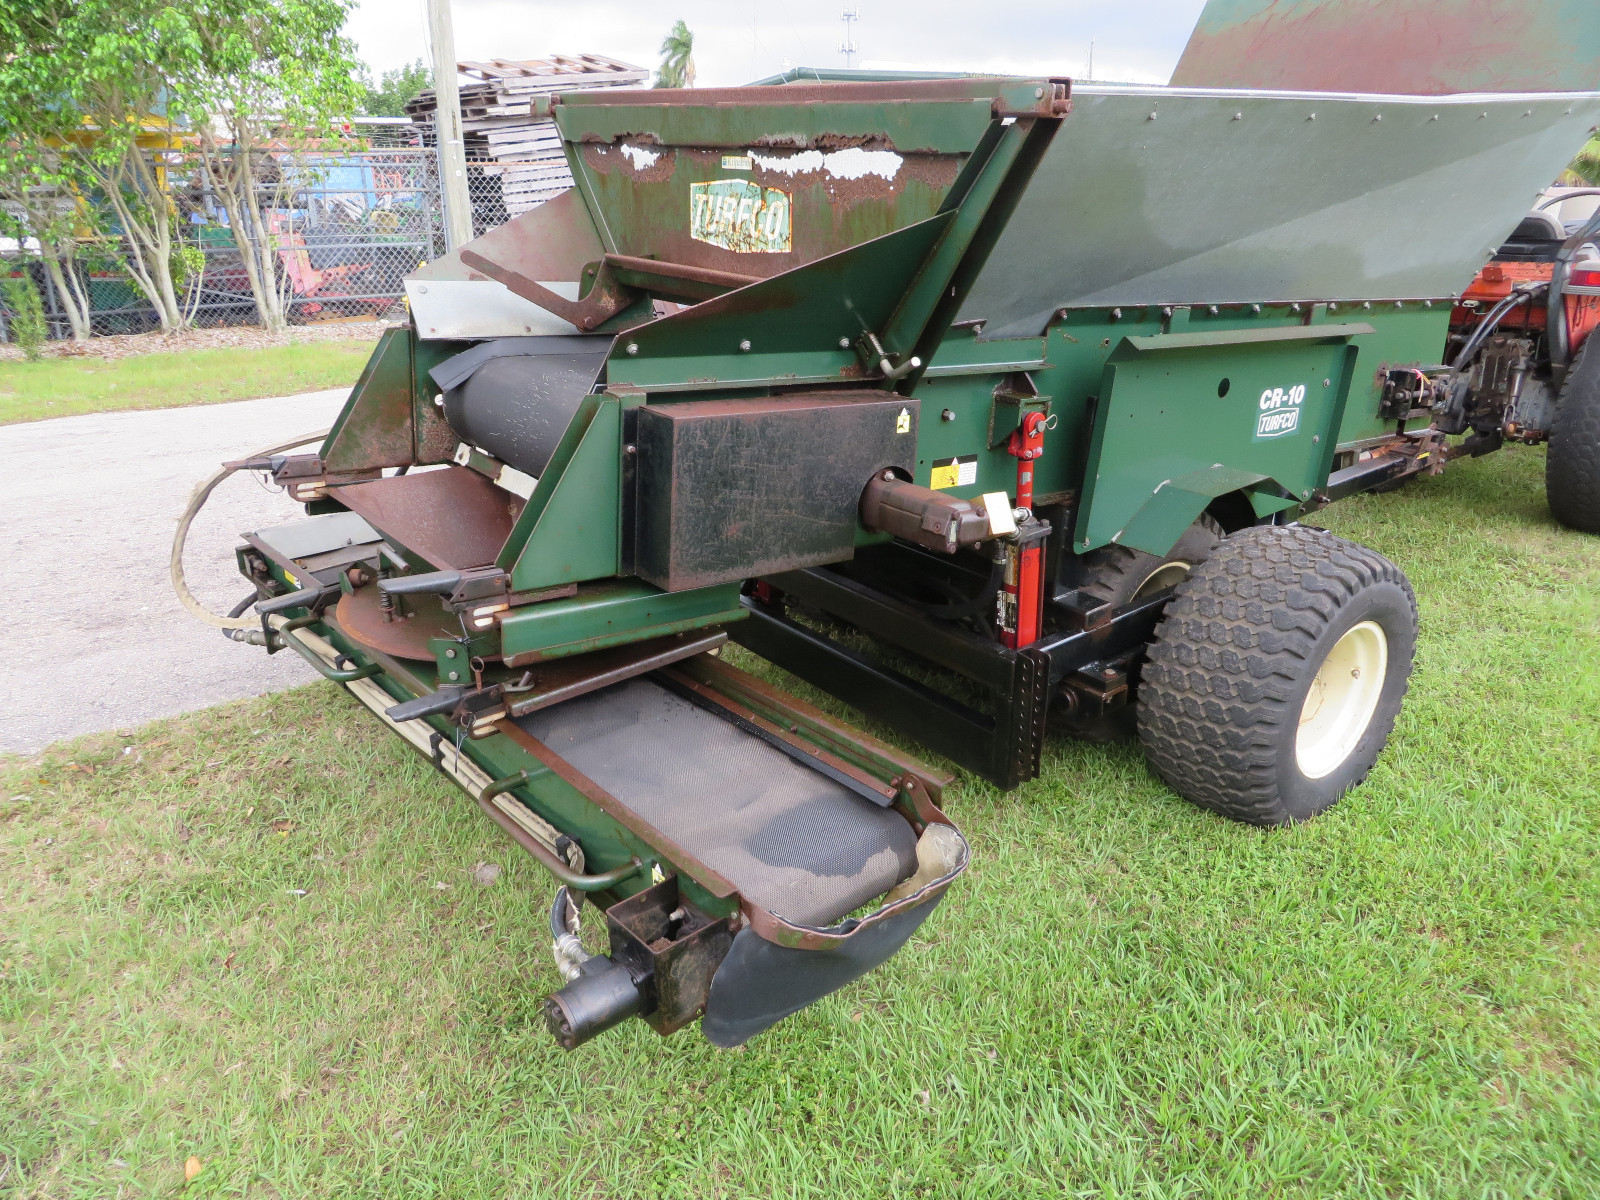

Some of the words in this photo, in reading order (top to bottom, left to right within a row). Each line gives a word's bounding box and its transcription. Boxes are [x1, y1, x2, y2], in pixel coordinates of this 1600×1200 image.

[694, 193, 785, 241] TURFCO
[1259, 384, 1305, 410] CR-10
[1259, 412, 1296, 433] TURFCO
